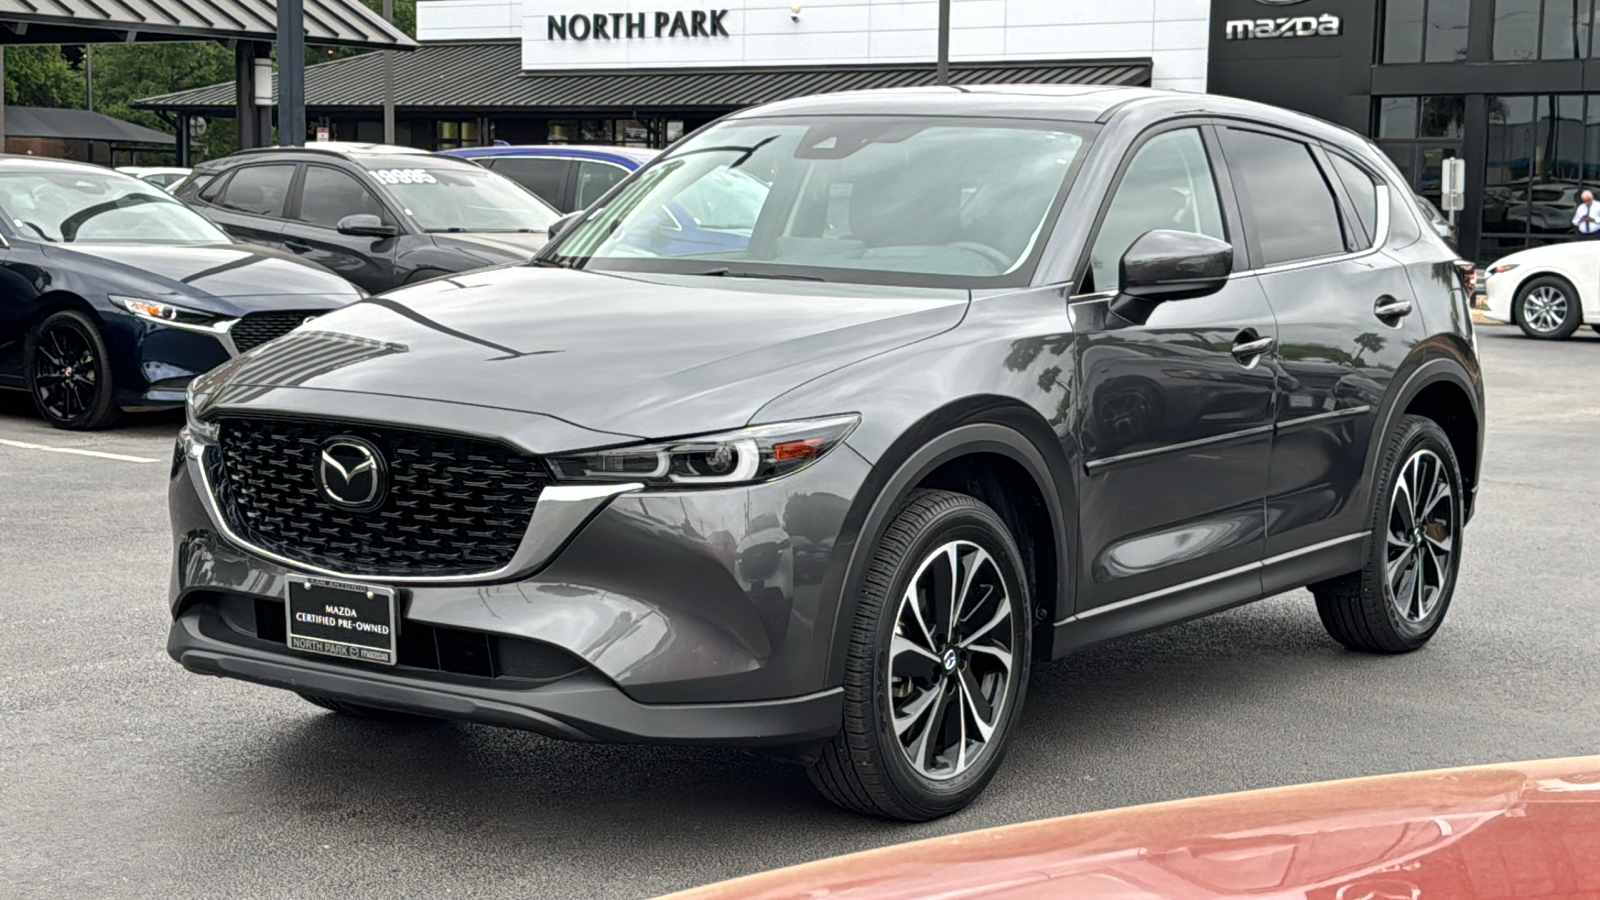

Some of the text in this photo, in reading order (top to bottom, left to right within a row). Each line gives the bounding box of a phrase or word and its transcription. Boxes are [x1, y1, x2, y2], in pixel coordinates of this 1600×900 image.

[548, 9, 729, 41] NORTH PARK
[325, 604, 357, 618] MAZDA
[295, 612, 389, 635] CERTIFIED PRE-OWNED
[293, 638, 323, 650] NORTH
[324, 643, 348, 656] PARK
